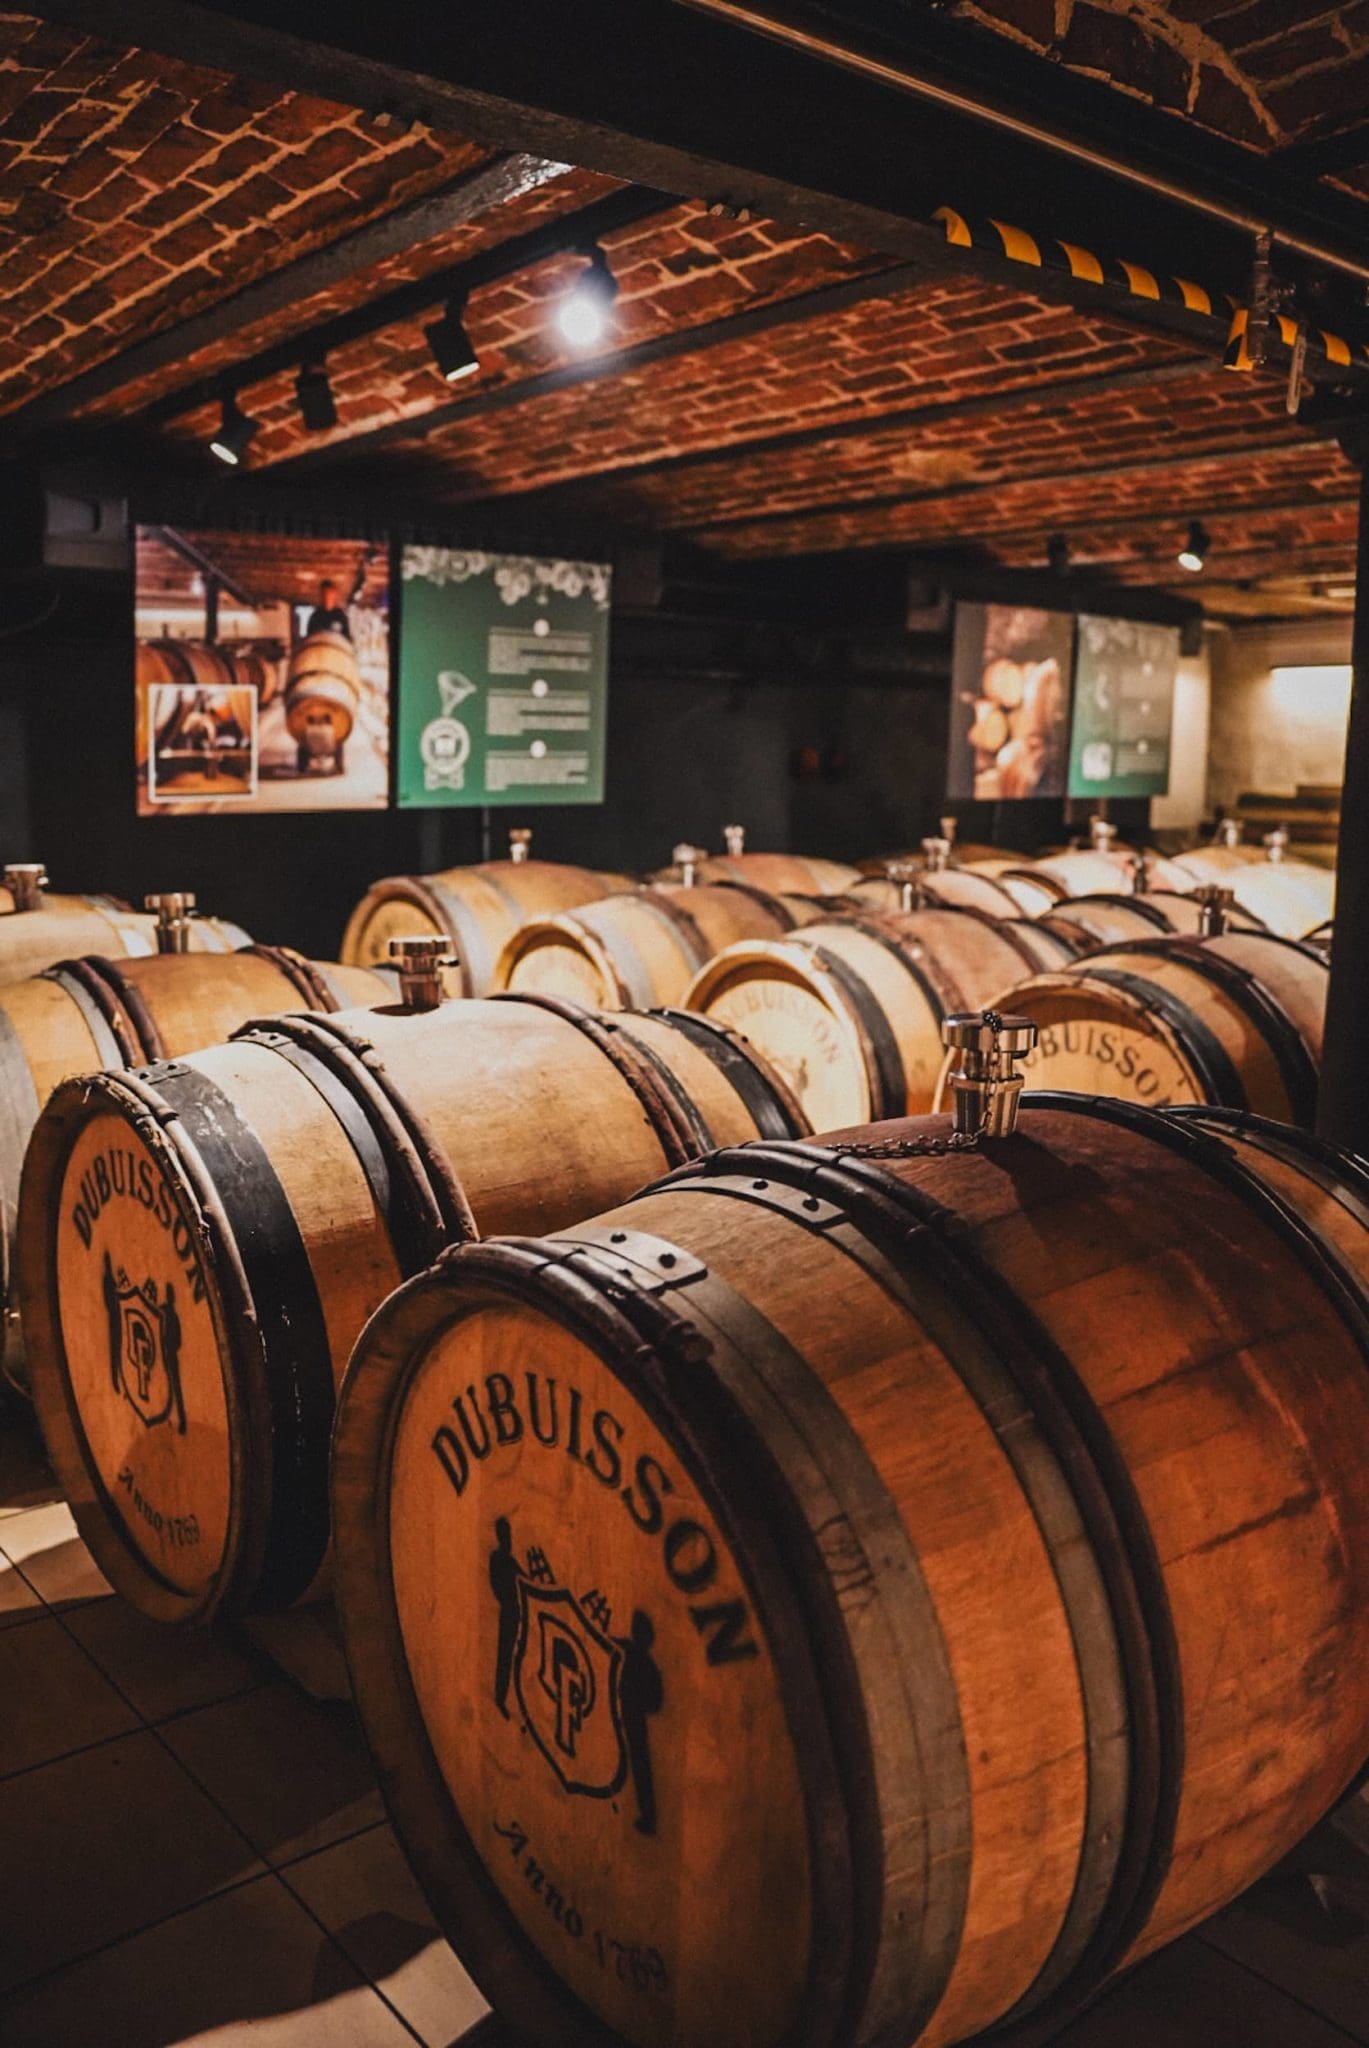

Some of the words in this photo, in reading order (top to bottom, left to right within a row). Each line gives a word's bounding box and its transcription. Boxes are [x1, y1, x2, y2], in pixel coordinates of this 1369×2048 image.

[1021, 1023, 1172, 1108] UBUISSO
[117, 1465, 164, 1533] Anno
[430, 1371, 761, 1669] DUBUISSON
[492, 1819, 584, 1938] Anno
